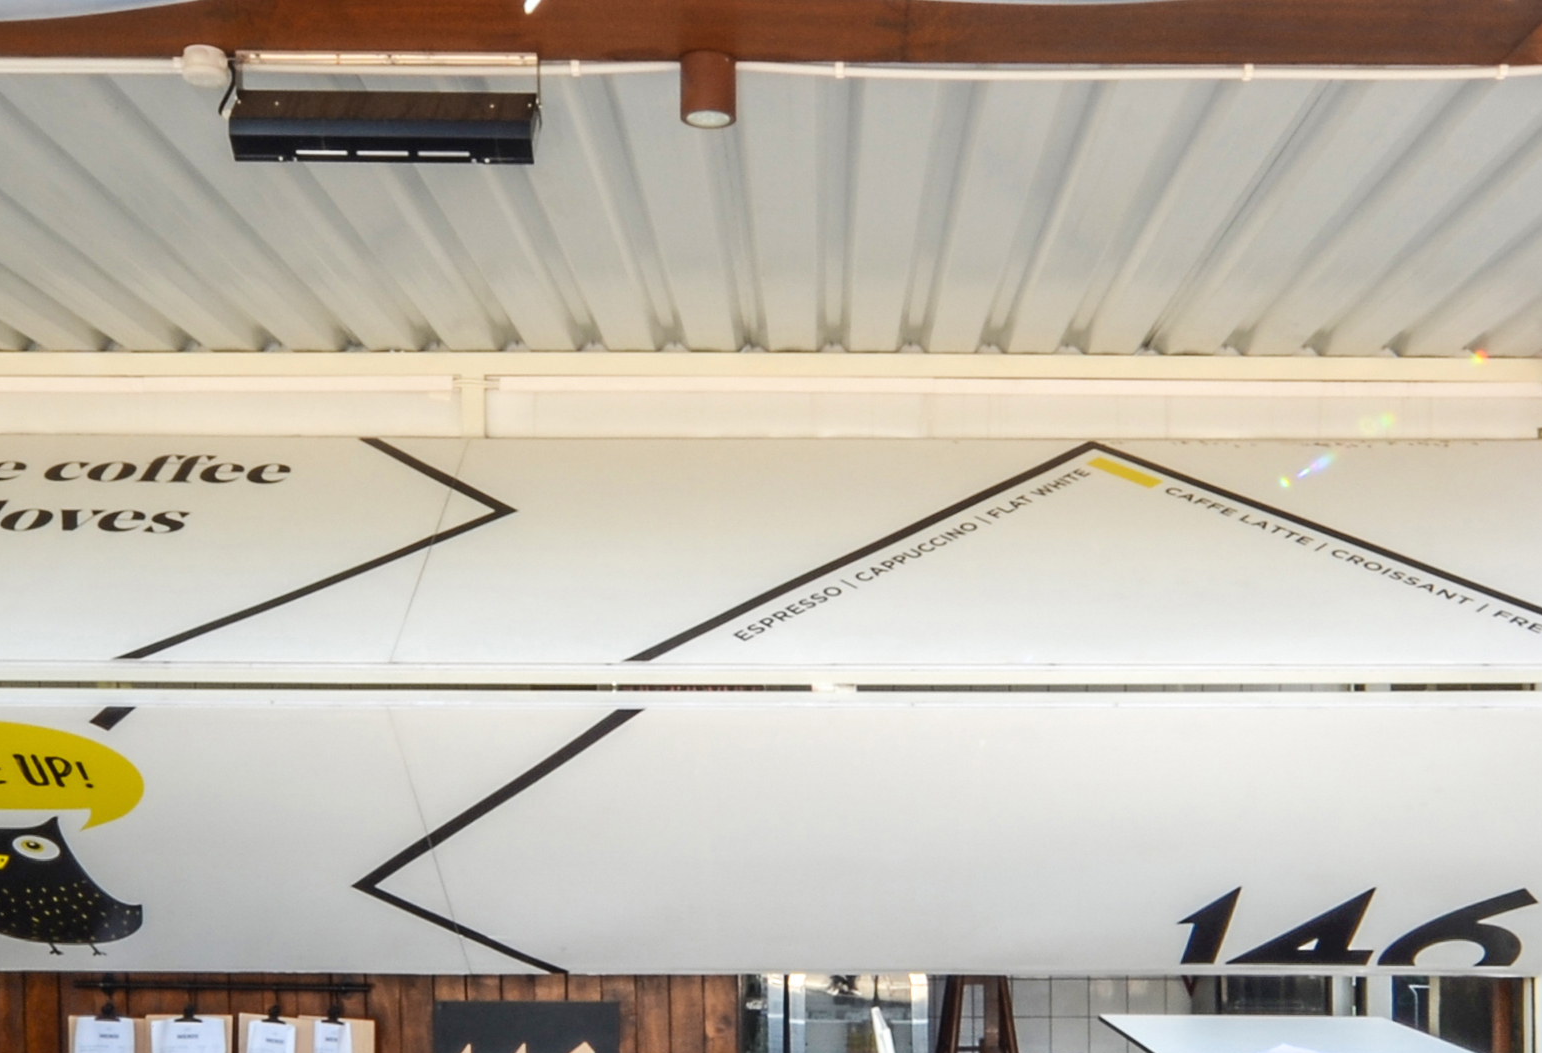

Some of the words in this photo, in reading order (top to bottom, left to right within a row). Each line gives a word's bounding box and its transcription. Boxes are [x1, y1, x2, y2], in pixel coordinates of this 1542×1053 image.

[43, 453, 292, 485] coffee
[733, 586, 842, 641] ESPRESSO
[855, 521, 978, 583] CAPPUCCINO
[986, 494, 1033, 520] FLAT
[1031, 468, 1091, 497] WHITE
[1165, 486, 1237, 517] CAFFE
[1239, 514, 1315, 547] LATTE
[1331, 548, 1474, 606] CROISSANT
[13, 754, 94, 789] UP!
[1176, 886, 1538, 967] 146
